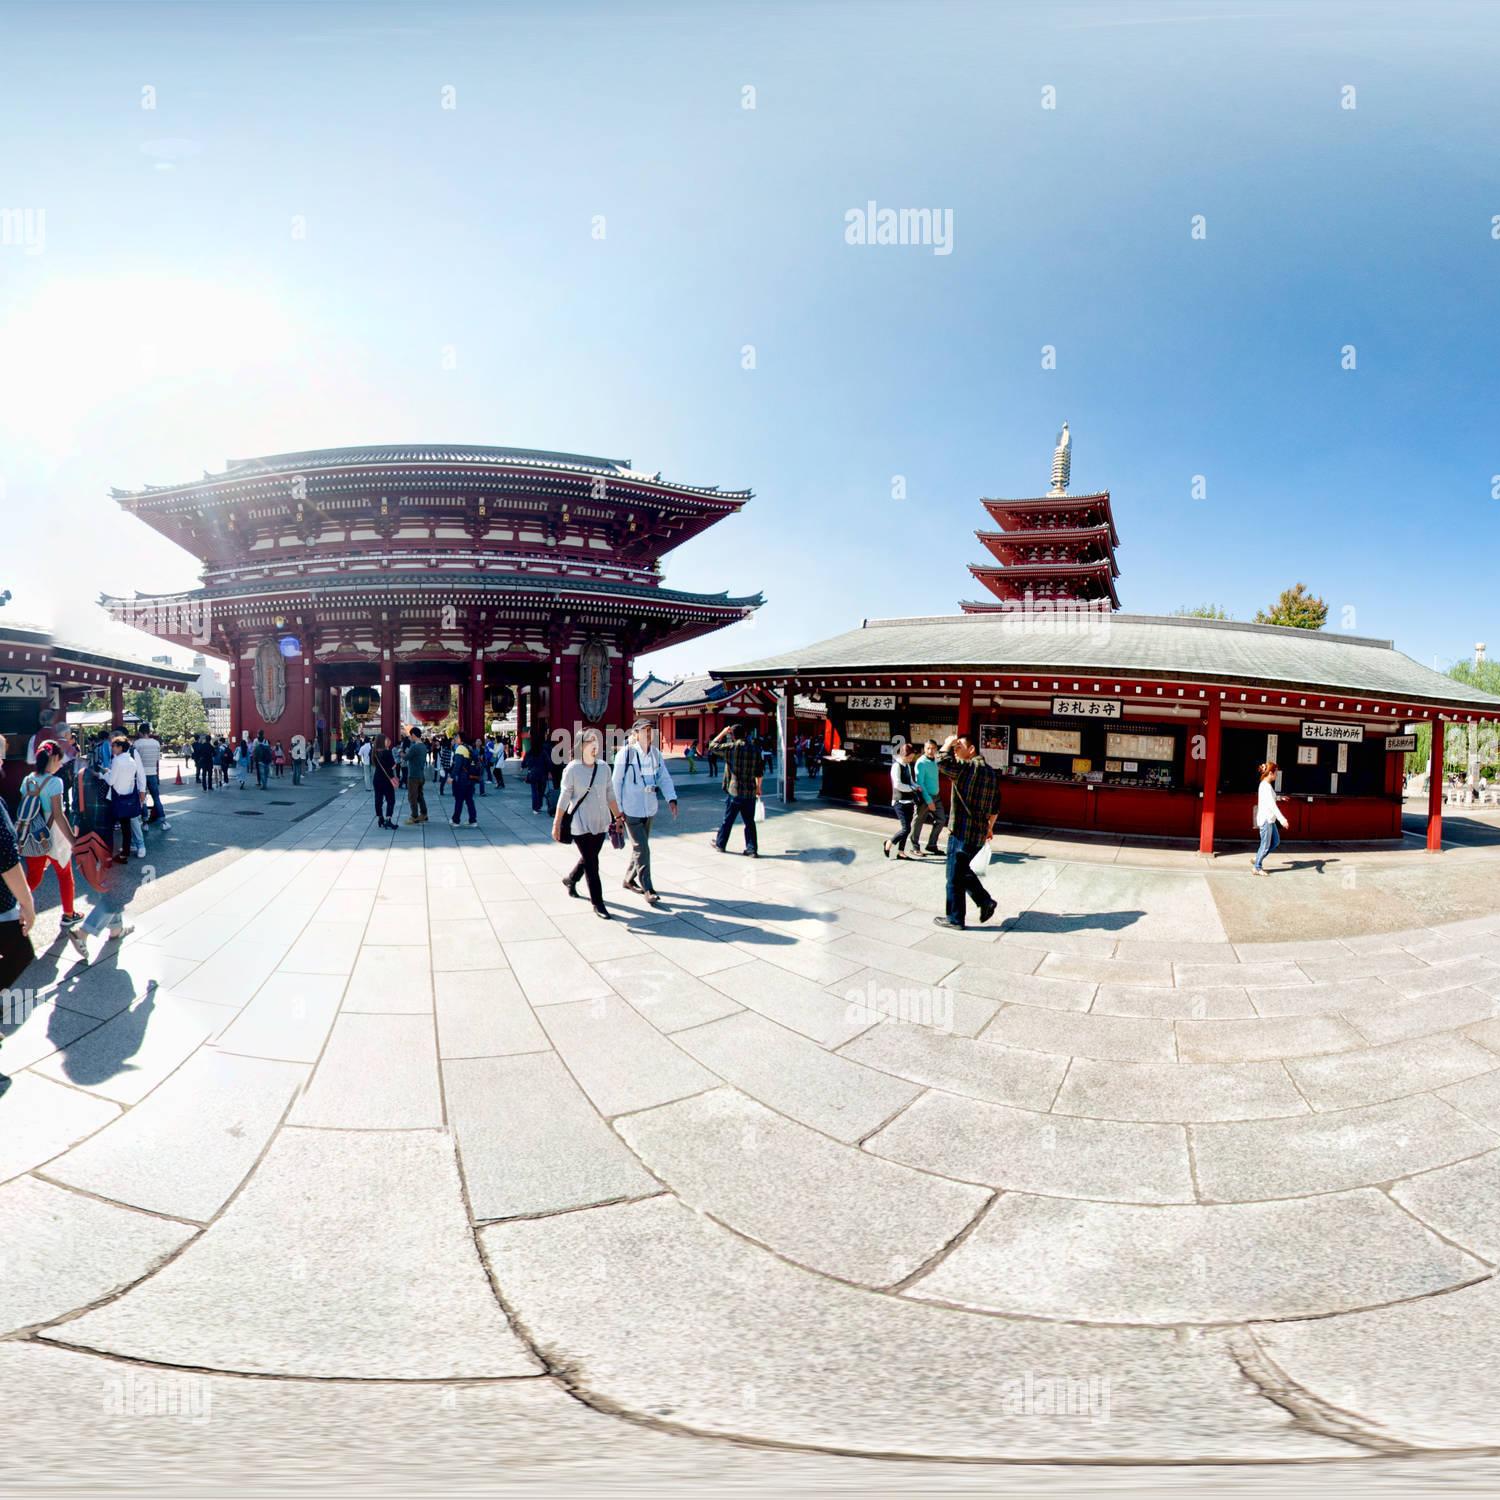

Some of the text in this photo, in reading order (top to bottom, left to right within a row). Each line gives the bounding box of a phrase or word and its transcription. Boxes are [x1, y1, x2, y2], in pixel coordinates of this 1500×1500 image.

[851, 697, 893, 709] お札お守
[1057, 700, 1116, 716] お札お守
[1304, 725, 1361, 740] 古札お納め所
